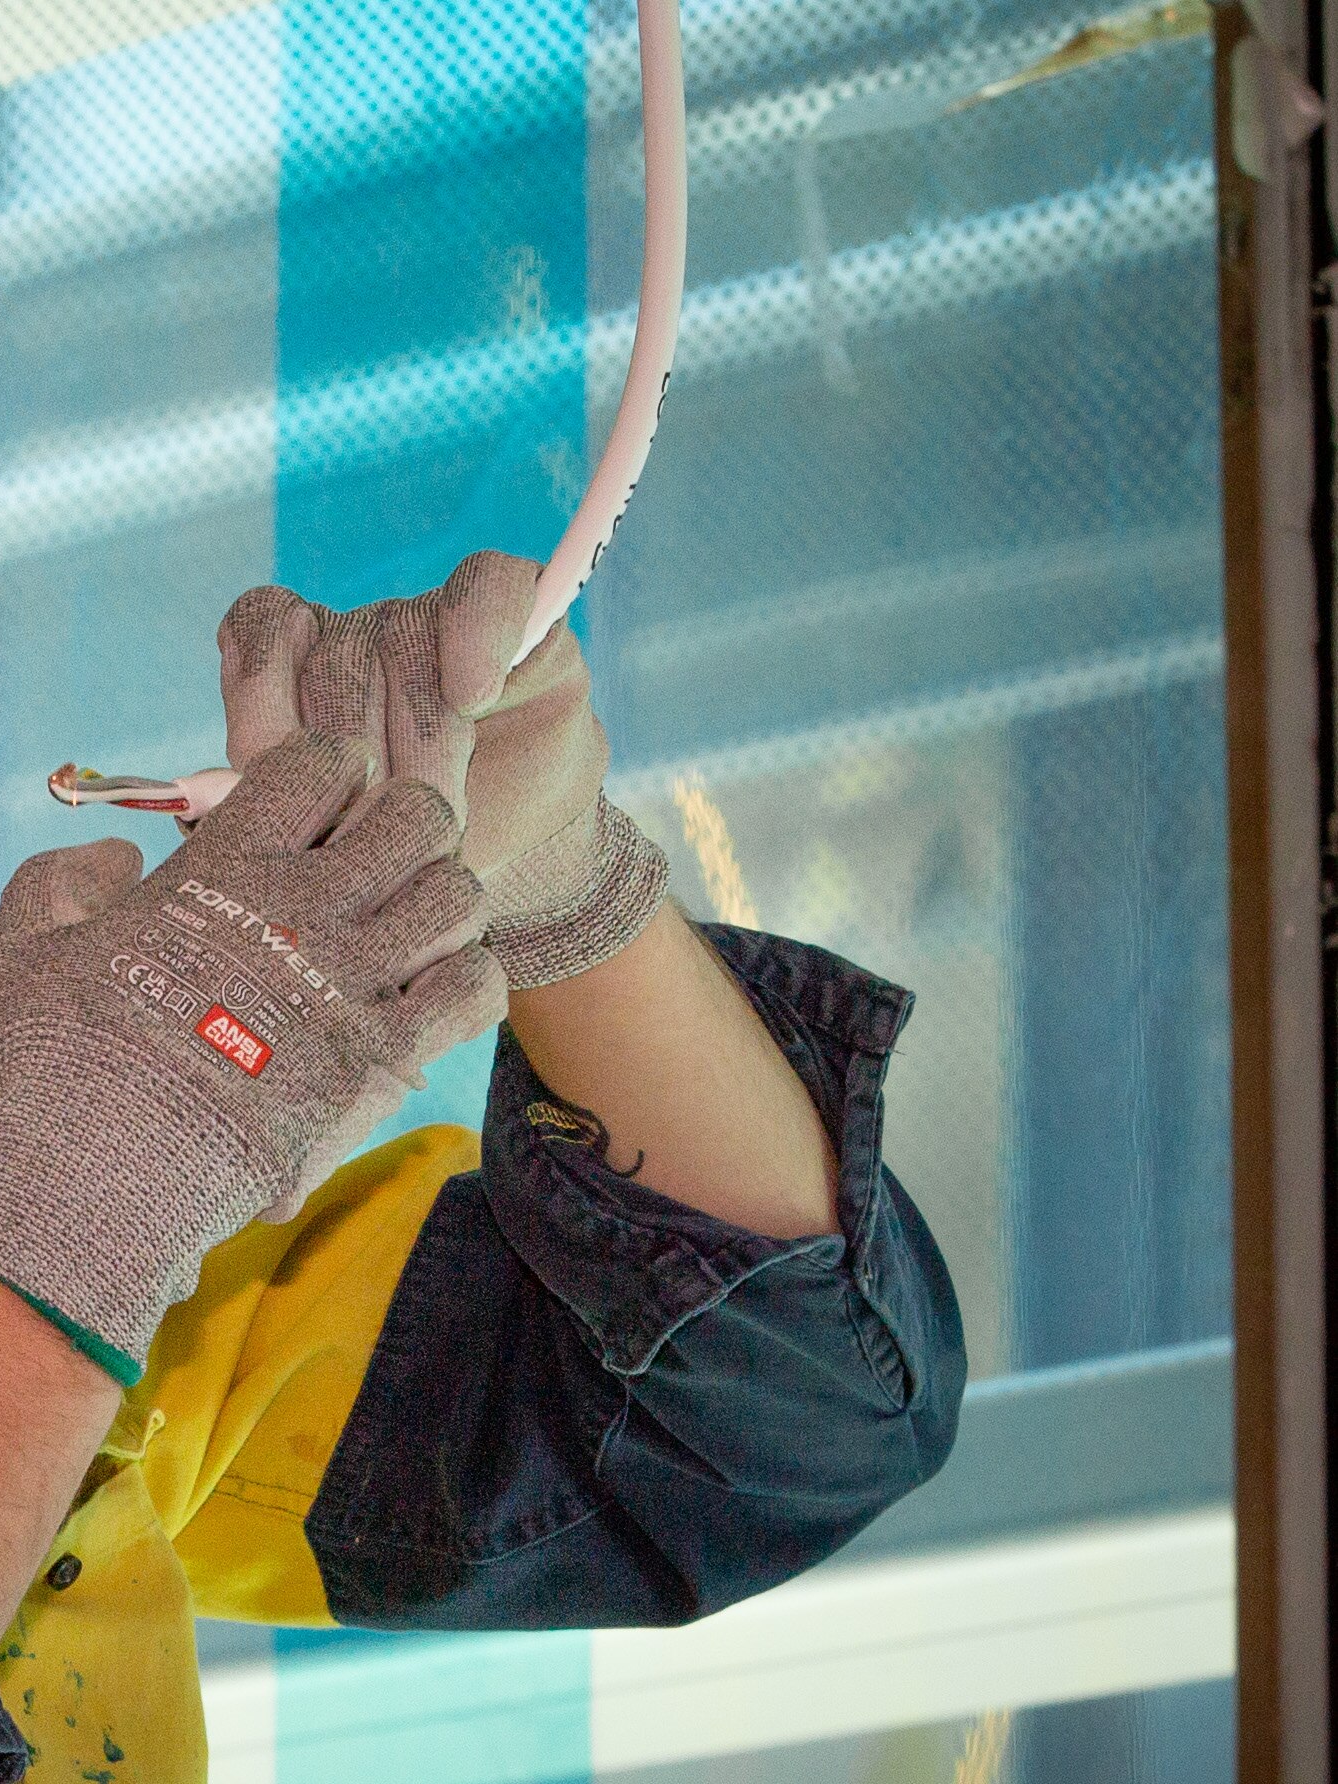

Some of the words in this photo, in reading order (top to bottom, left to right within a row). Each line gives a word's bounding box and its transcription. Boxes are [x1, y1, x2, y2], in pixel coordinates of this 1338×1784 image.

[176, 878, 344, 1003] PORTWEST
[110, 954, 151, 985] CE
[147, 969, 170, 991] UK
[139, 980, 164, 1002] CA
[204, 1024, 235, 1051] CUT
[233, 1050, 256, 1069] A3
[212, 1016, 263, 1060] ANSI
